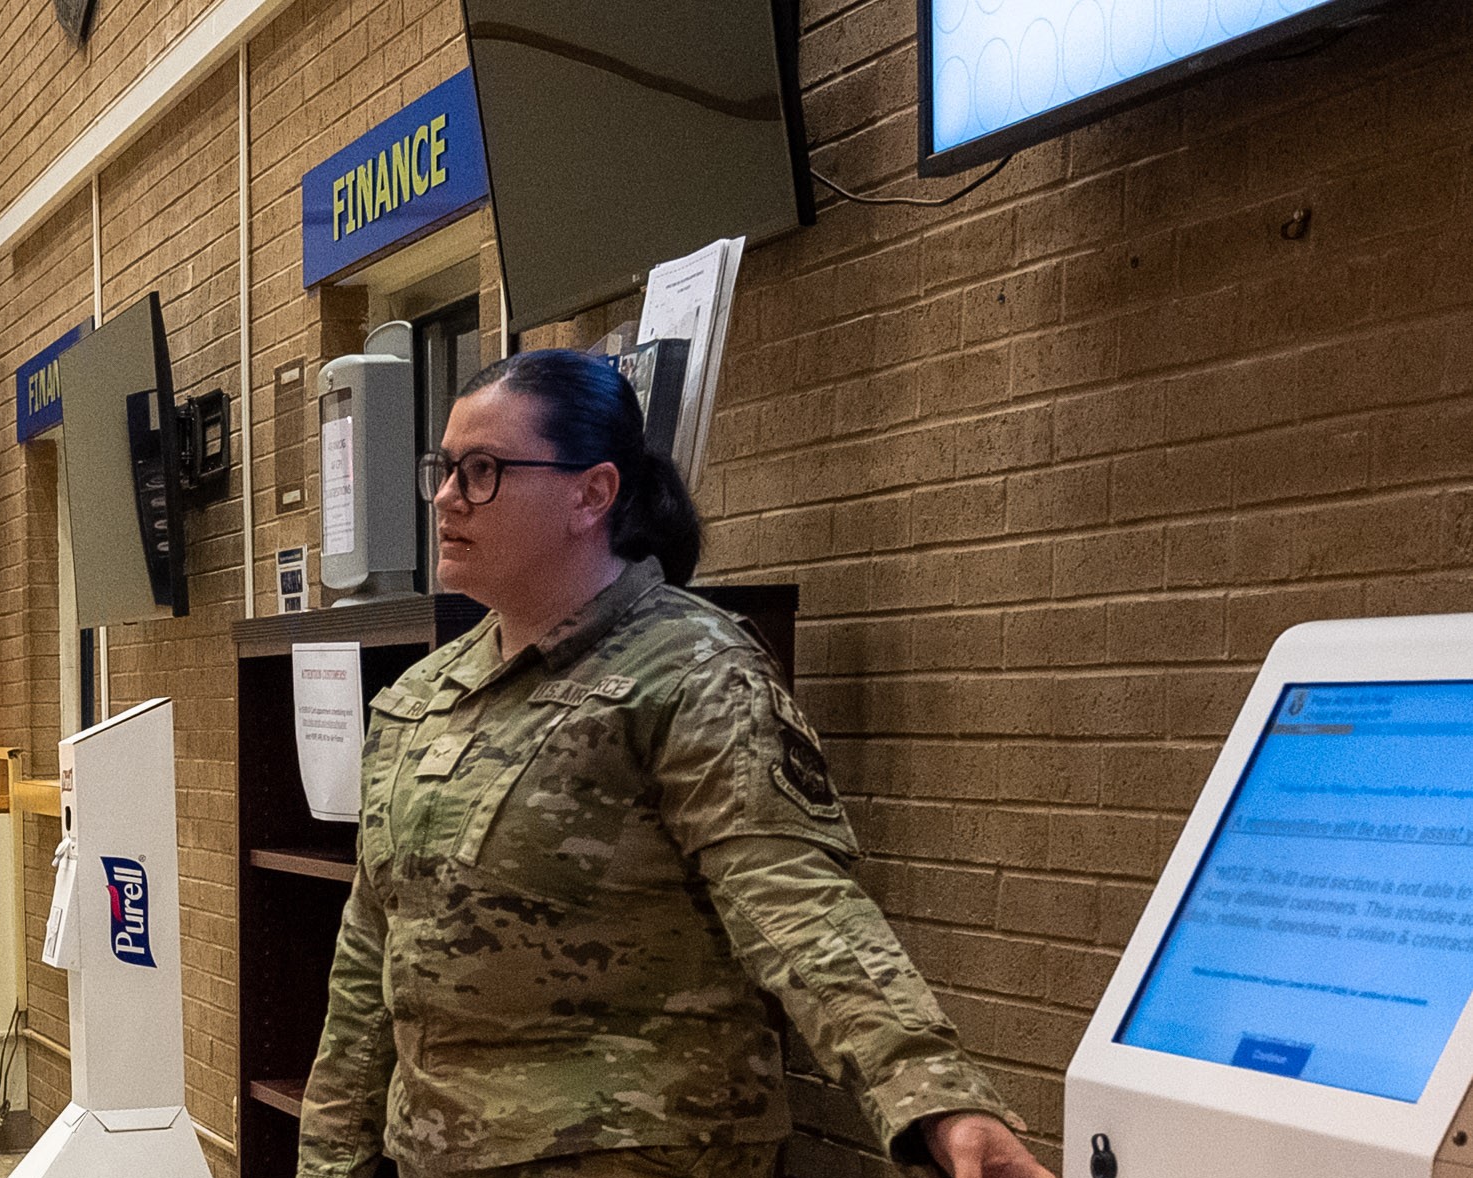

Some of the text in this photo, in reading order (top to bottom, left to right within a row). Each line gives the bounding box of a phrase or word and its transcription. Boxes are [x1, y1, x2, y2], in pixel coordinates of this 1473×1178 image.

[333, 113, 449, 241] FINANCE
[29, 359, 60, 416] FINAN
[115, 866, 145, 956] Purell
[1327, 875, 1381, 894] section
[1361, 901, 1396, 919] This
